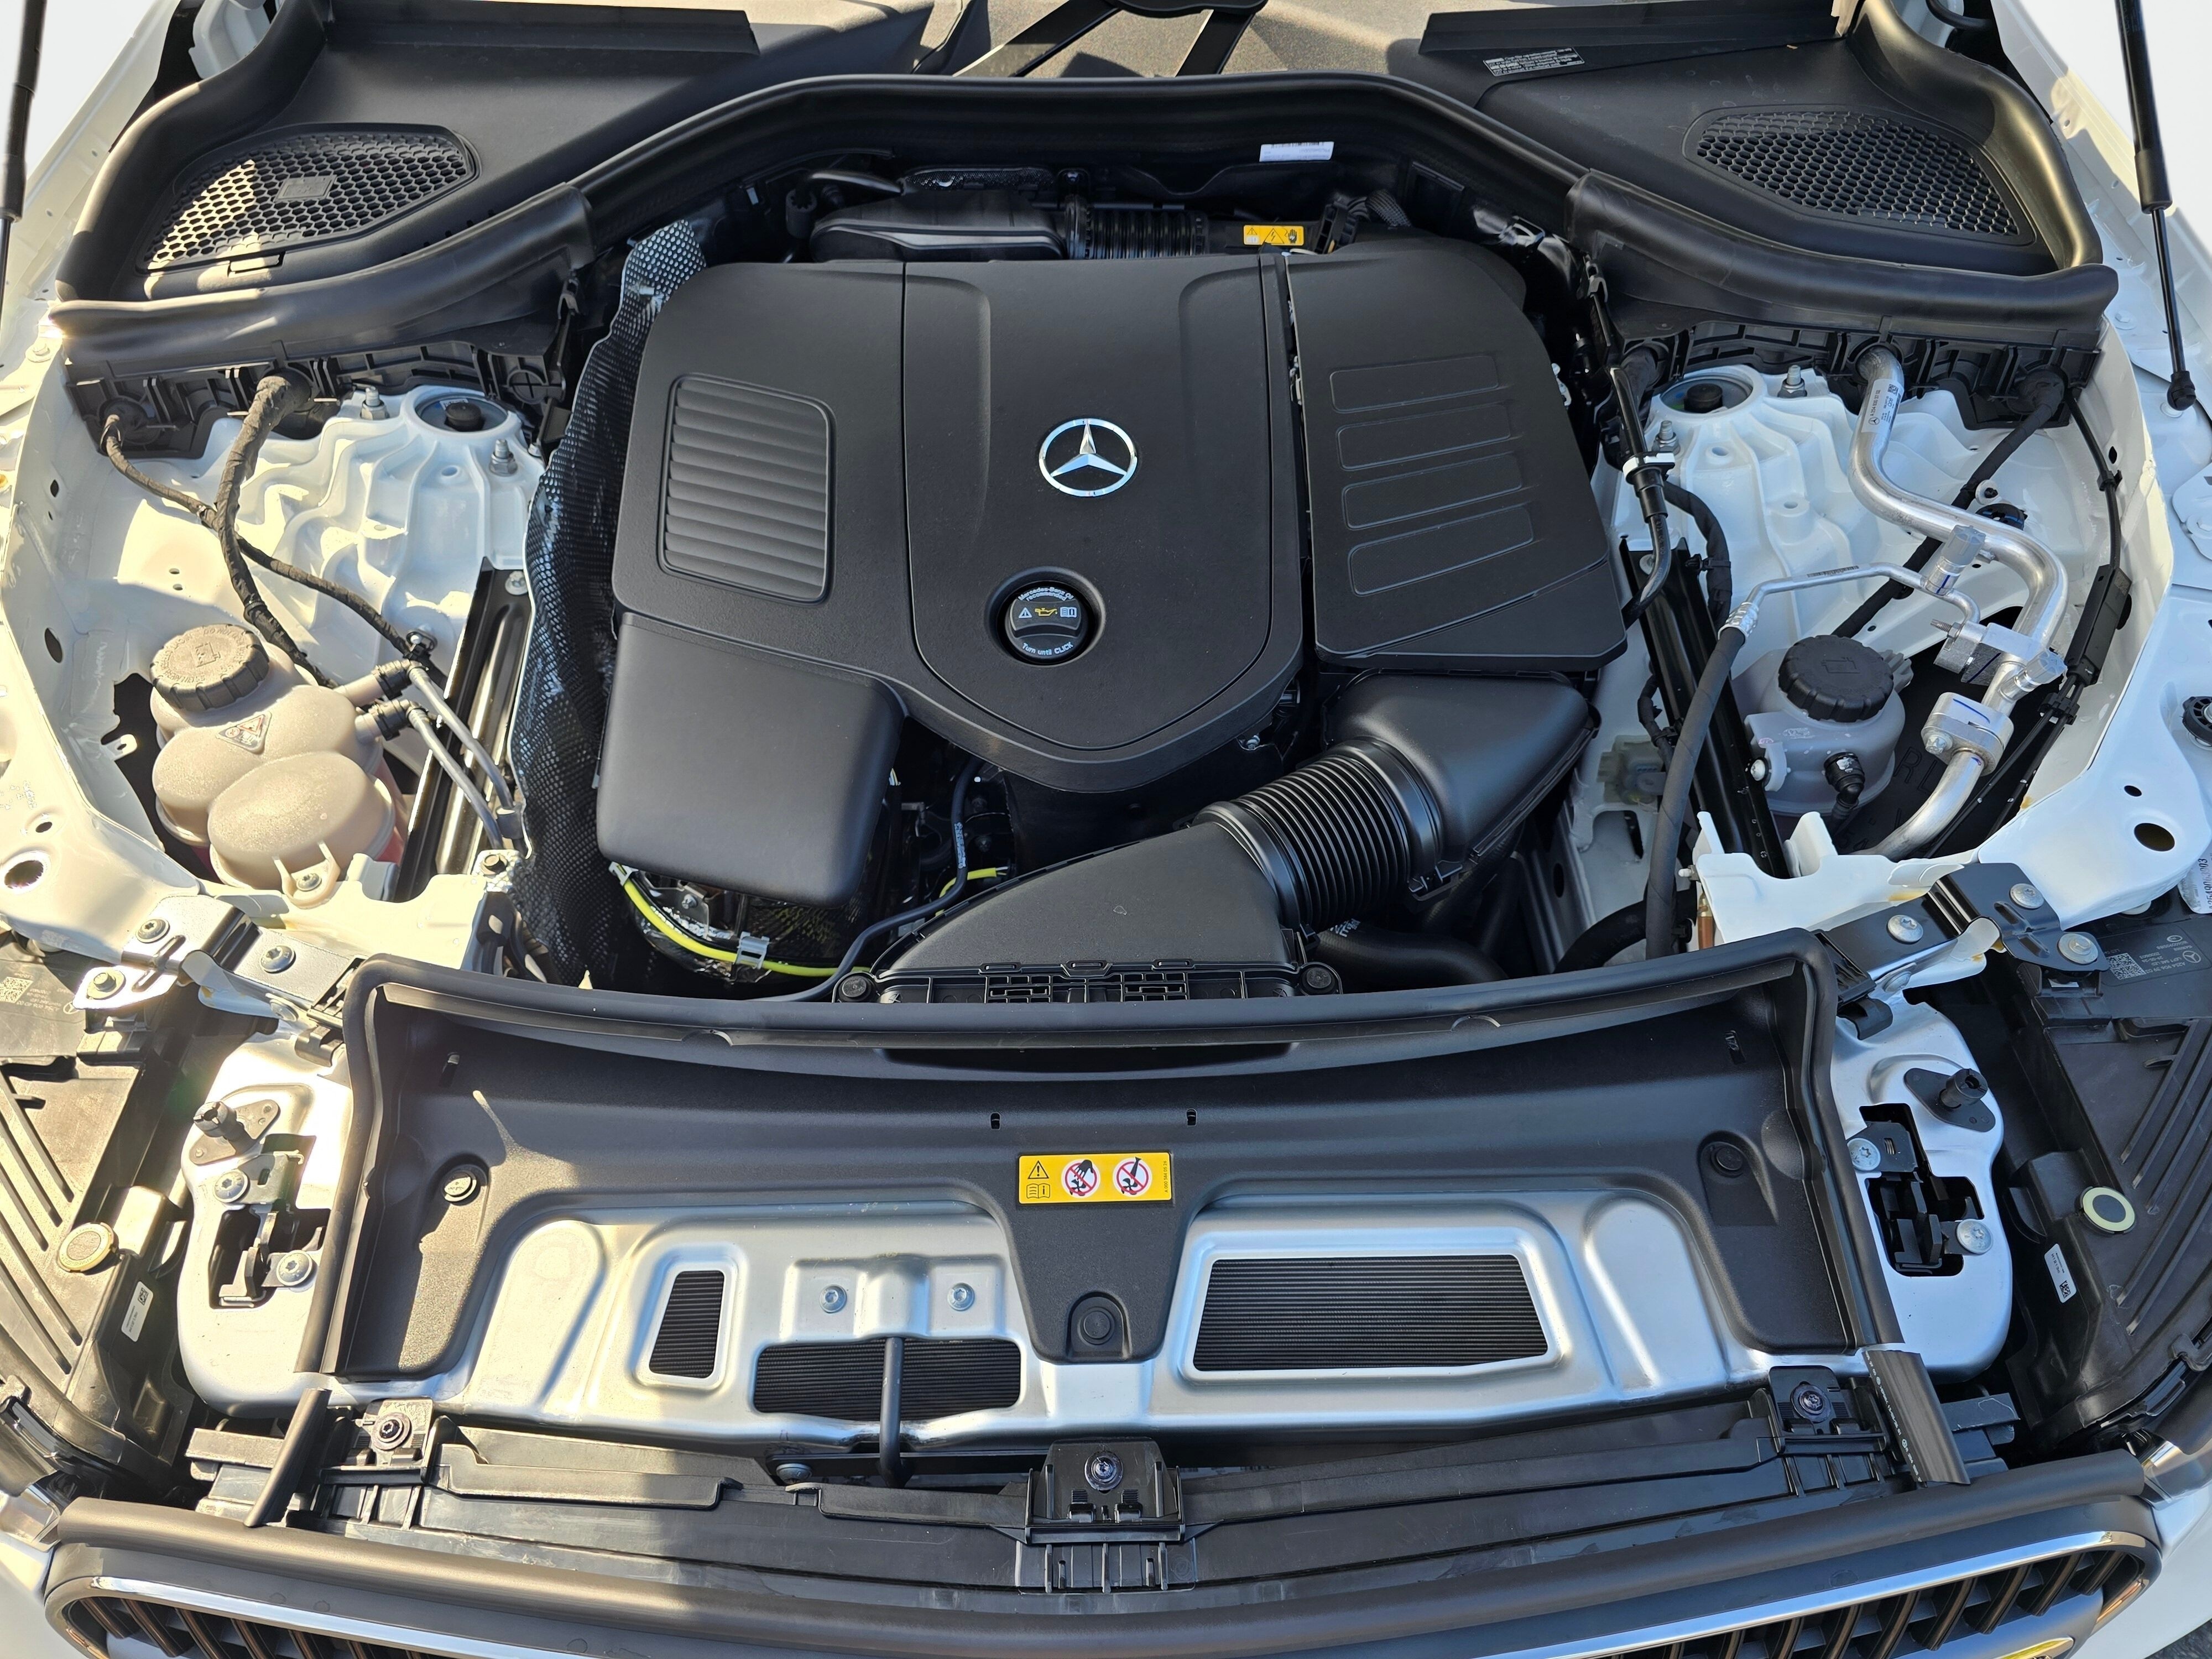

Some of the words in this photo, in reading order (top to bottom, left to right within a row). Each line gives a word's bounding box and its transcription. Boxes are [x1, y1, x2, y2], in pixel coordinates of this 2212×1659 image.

[1018, 587, 1066, 601] Mercedes-Benz
[1026, 592, 1067, 602] recommended
[1022, 643, 1036, 654] Turn
[1054, 641, 1074, 654] CLICK
